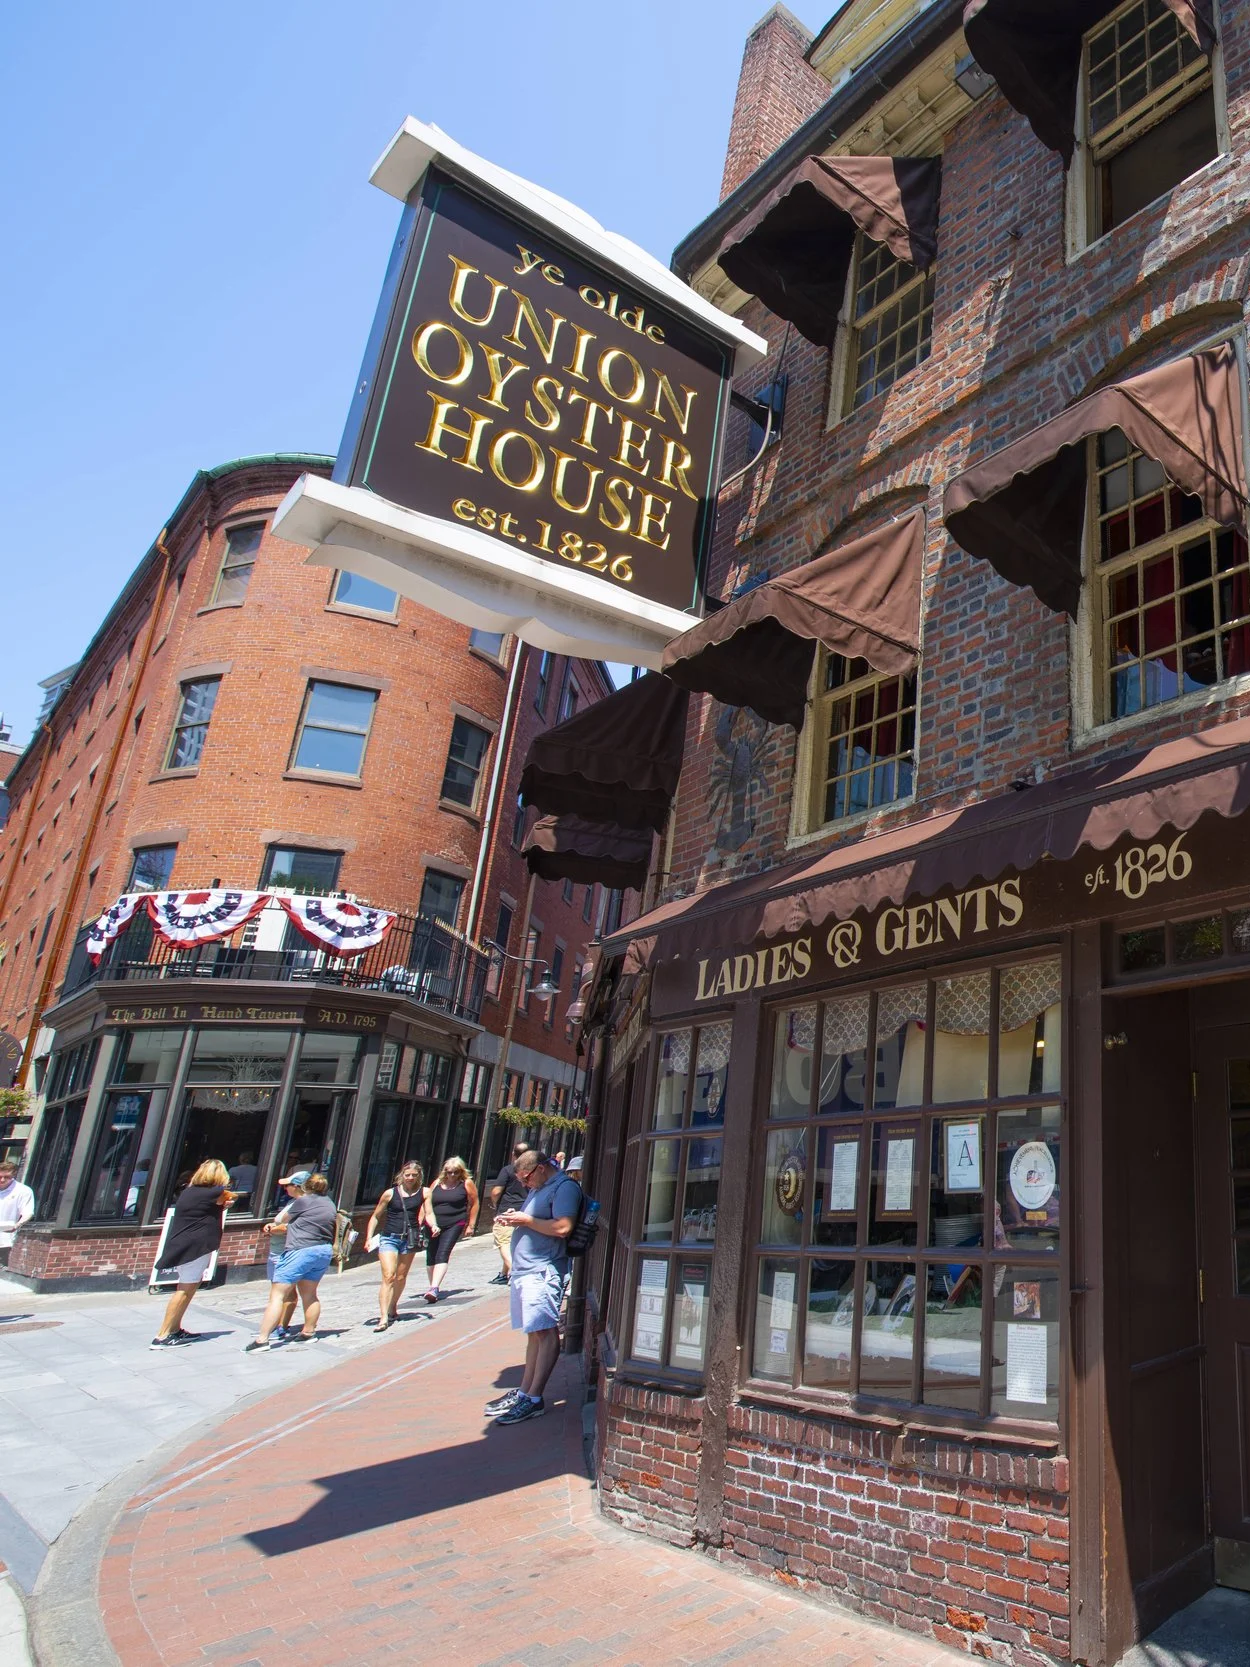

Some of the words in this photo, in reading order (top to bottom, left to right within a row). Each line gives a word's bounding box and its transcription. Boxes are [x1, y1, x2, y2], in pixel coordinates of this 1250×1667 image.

[448, 254, 698, 435] UNION
[513, 243, 565, 286] ye
[578, 284, 666, 345] olde
[411, 320, 699, 501] OYSTER
[414, 390, 673, 550] HOUSE
[1114, 832, 1193, 900] 1826
[694, 937, 812, 1000] LADIES
[826, 920, 863, 969] &
[875, 877, 1024, 956] GENTS
[112, 1008, 136, 1022] The
[141, 1006, 167, 1020] Bell
[172, 1006, 187, 1019] In
[201, 1006, 243, 1019] Hand
[247, 1007, 297, 1020] Tavern
[354, 1015, 377, 1027] 1795
[956, 1140, 974, 1167] A
